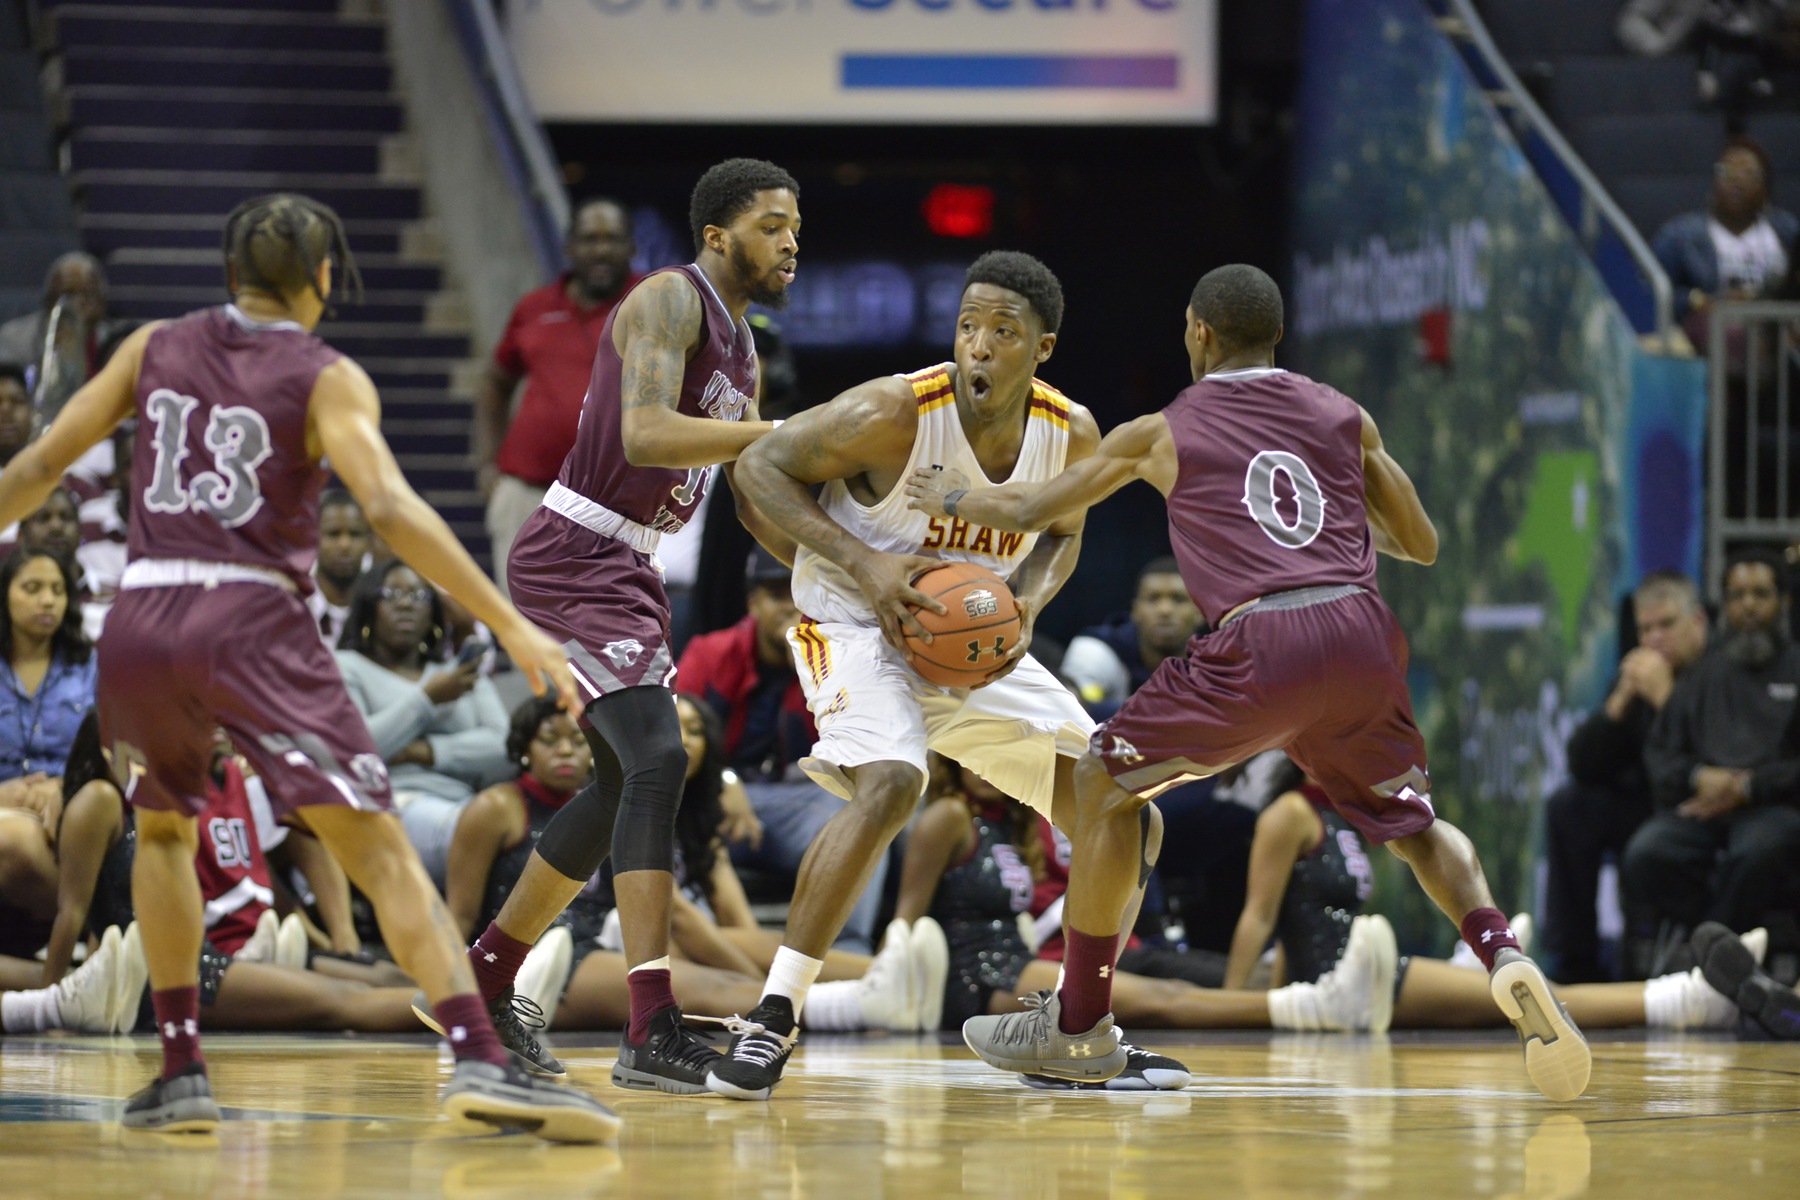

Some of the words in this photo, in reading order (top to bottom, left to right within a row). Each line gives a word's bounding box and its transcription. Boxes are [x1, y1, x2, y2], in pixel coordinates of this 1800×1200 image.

[143, 388, 274, 529] 13
[1240, 450, 1328, 549] 0
[923, 515, 1026, 559] SHAW
